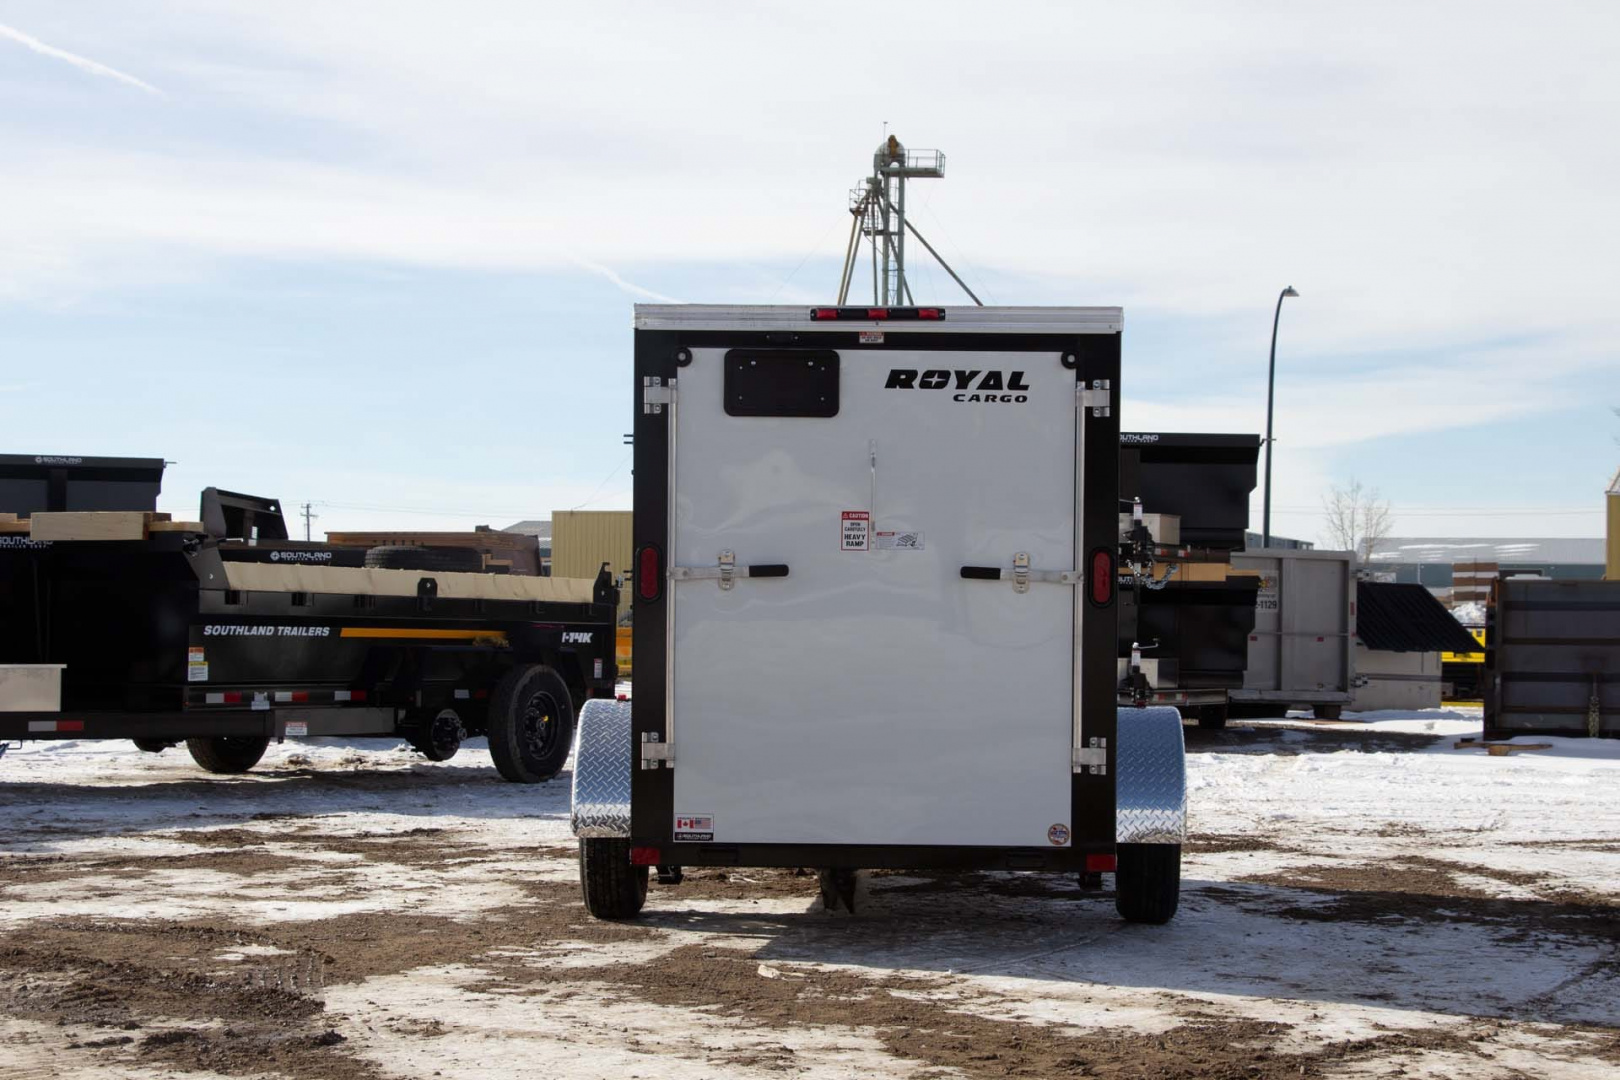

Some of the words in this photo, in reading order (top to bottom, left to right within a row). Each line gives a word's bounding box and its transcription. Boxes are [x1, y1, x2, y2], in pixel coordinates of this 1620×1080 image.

[884, 369, 1030, 391] ROYAL
[953, 394, 1028, 403] CARGO
[280, 551, 332, 559] SOUTHLAND
[203, 625, 275, 636] SOUTHLAND
[277, 626, 330, 636] TRAILERS
